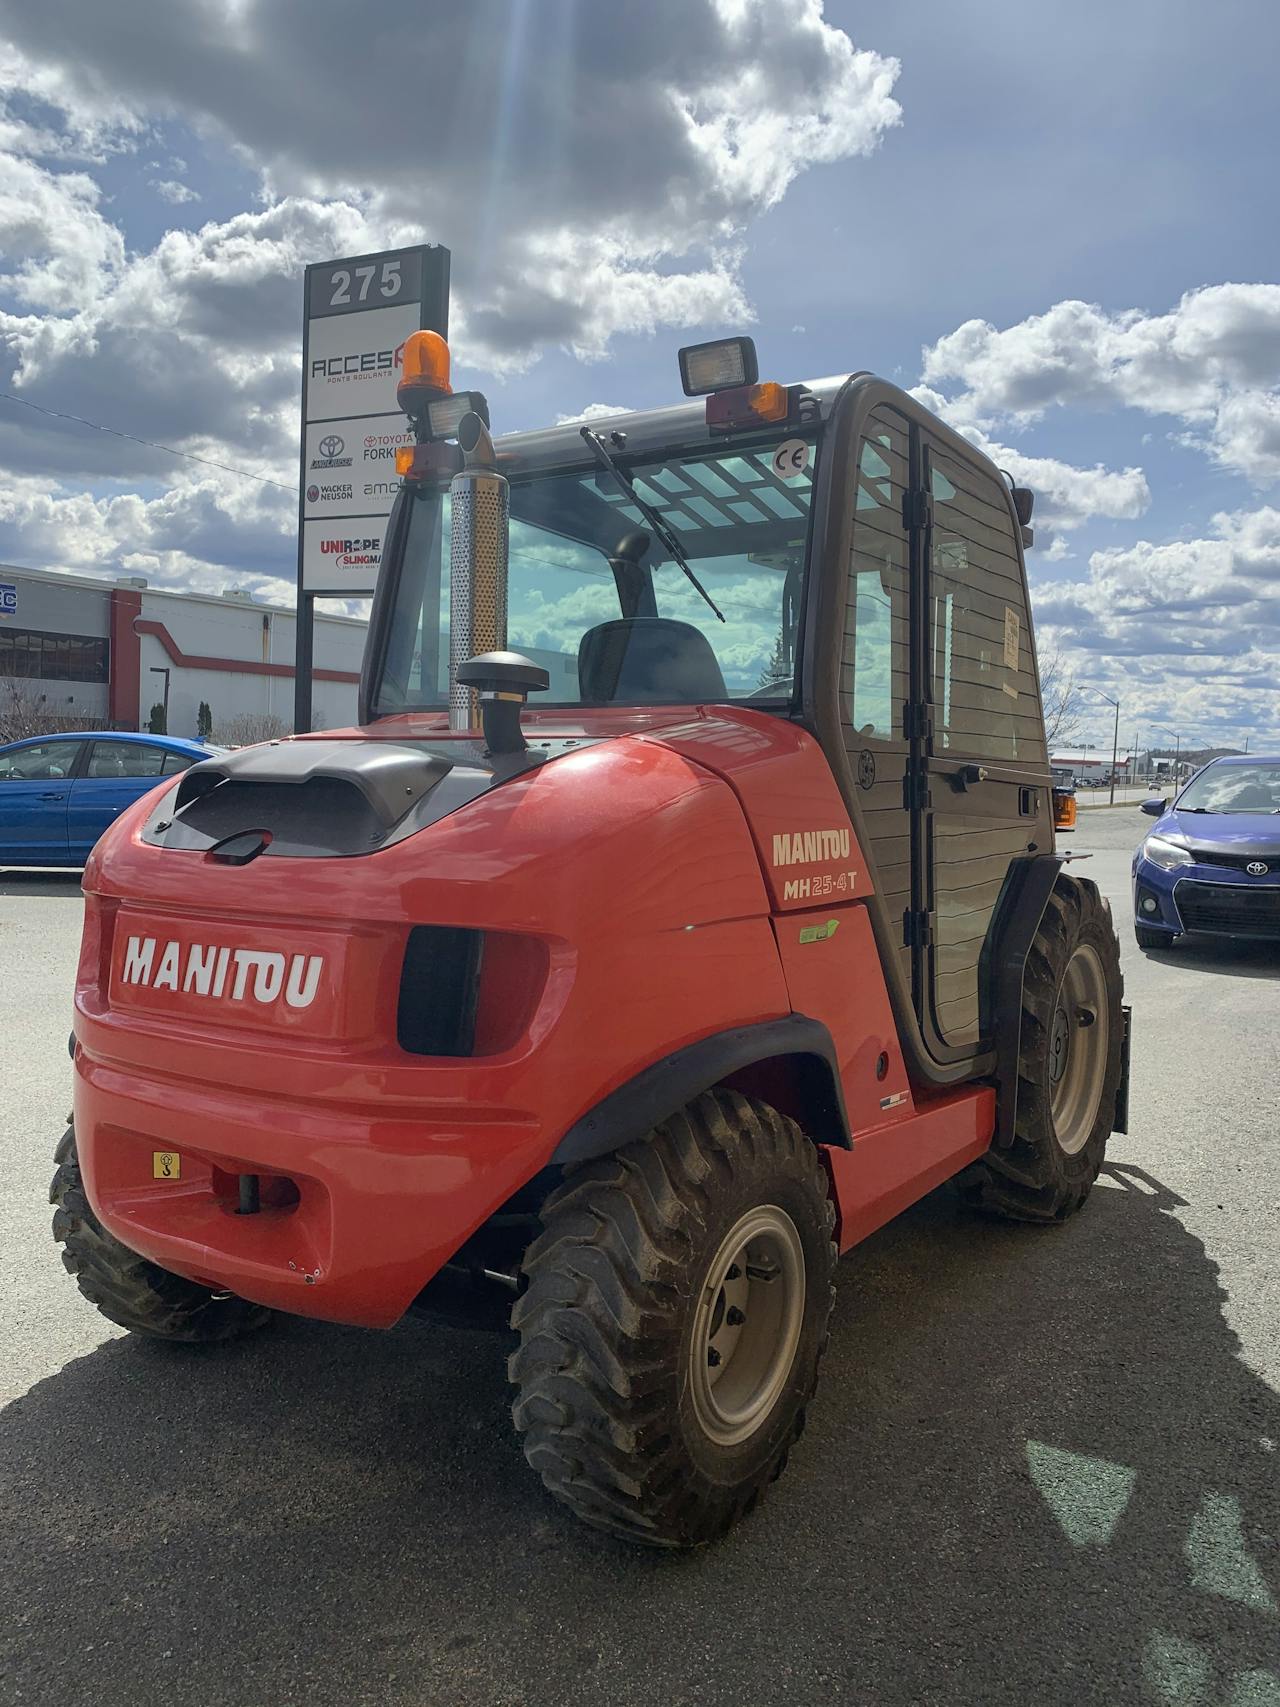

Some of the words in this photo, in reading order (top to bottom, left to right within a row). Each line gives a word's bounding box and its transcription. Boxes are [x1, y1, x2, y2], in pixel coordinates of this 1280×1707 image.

[330, 261, 402, 306] 275
[377, 434, 413, 445] TOYOTA
[775, 447, 804, 470] CE
[320, 484, 353, 493] WACKER
[320, 492, 353, 501] NEUSON
[773, 829, 850, 867] MANITOU
[122, 936, 324, 1008] MANITOU
